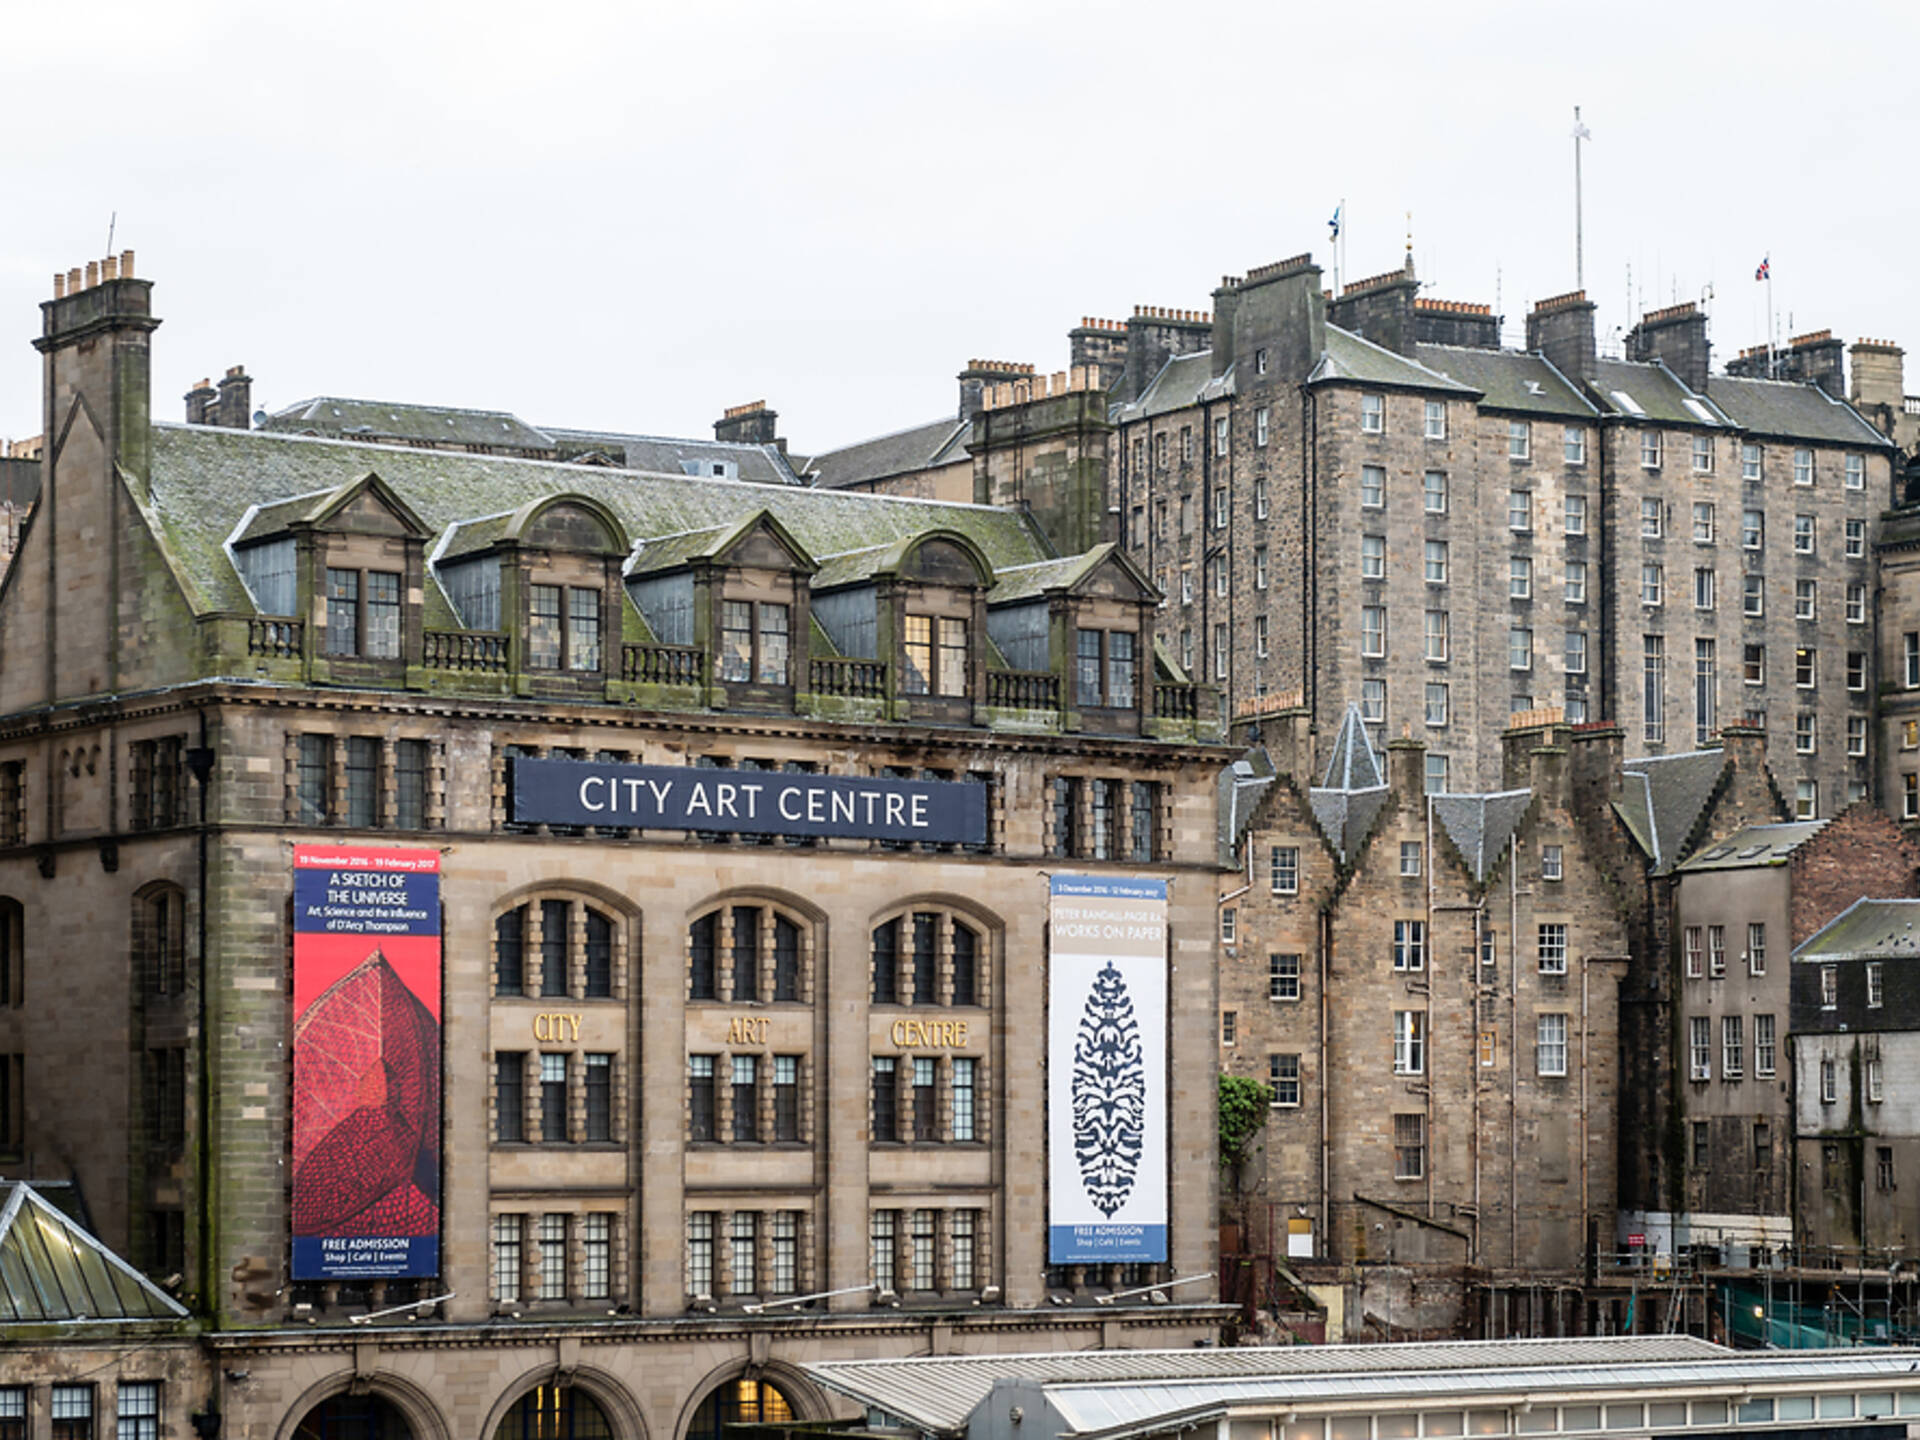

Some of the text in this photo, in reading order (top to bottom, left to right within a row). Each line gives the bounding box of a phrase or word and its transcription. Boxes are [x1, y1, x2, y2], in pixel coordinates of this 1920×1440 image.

[579, 776, 929, 827] CITY ART CENTRE
[299, 856, 308, 864] 19
[310, 856, 348, 865] November
[349, 857, 368, 866] 2016
[374, 857, 383, 866] 19
[385, 858, 416, 870] February
[417, 860, 436, 868] 2017
[330, 873, 406, 887] A SKETCH OF
[327, 890, 408, 905] THE UNIVERSE
[1063, 884, 1092, 893] December
[1120, 886, 1144, 898] February
[307, 906, 323, 917] Art,
[324, 906, 355, 917] Science
[357, 908, 374, 918] and
[376, 908, 389, 918] the
[1055, 907, 1080, 919] PETER
[326, 919, 409, 932] of D'Arcy Thompson
[1055, 924, 1161, 941] WORKS ON PAPER
[533, 1013, 967, 1048] CITY ART CENTRE
[1074, 1225, 1144, 1236] FREE ADMISSION
[322, 1238, 409, 1250] FREE ADMISSION
[1076, 1238, 1093, 1248] Shop
[1120, 1238, 1142, 1246] Events
[324, 1252, 346, 1263] Shop
[352, 1251, 372, 1262] Café
[379, 1252, 407, 1261] Events
